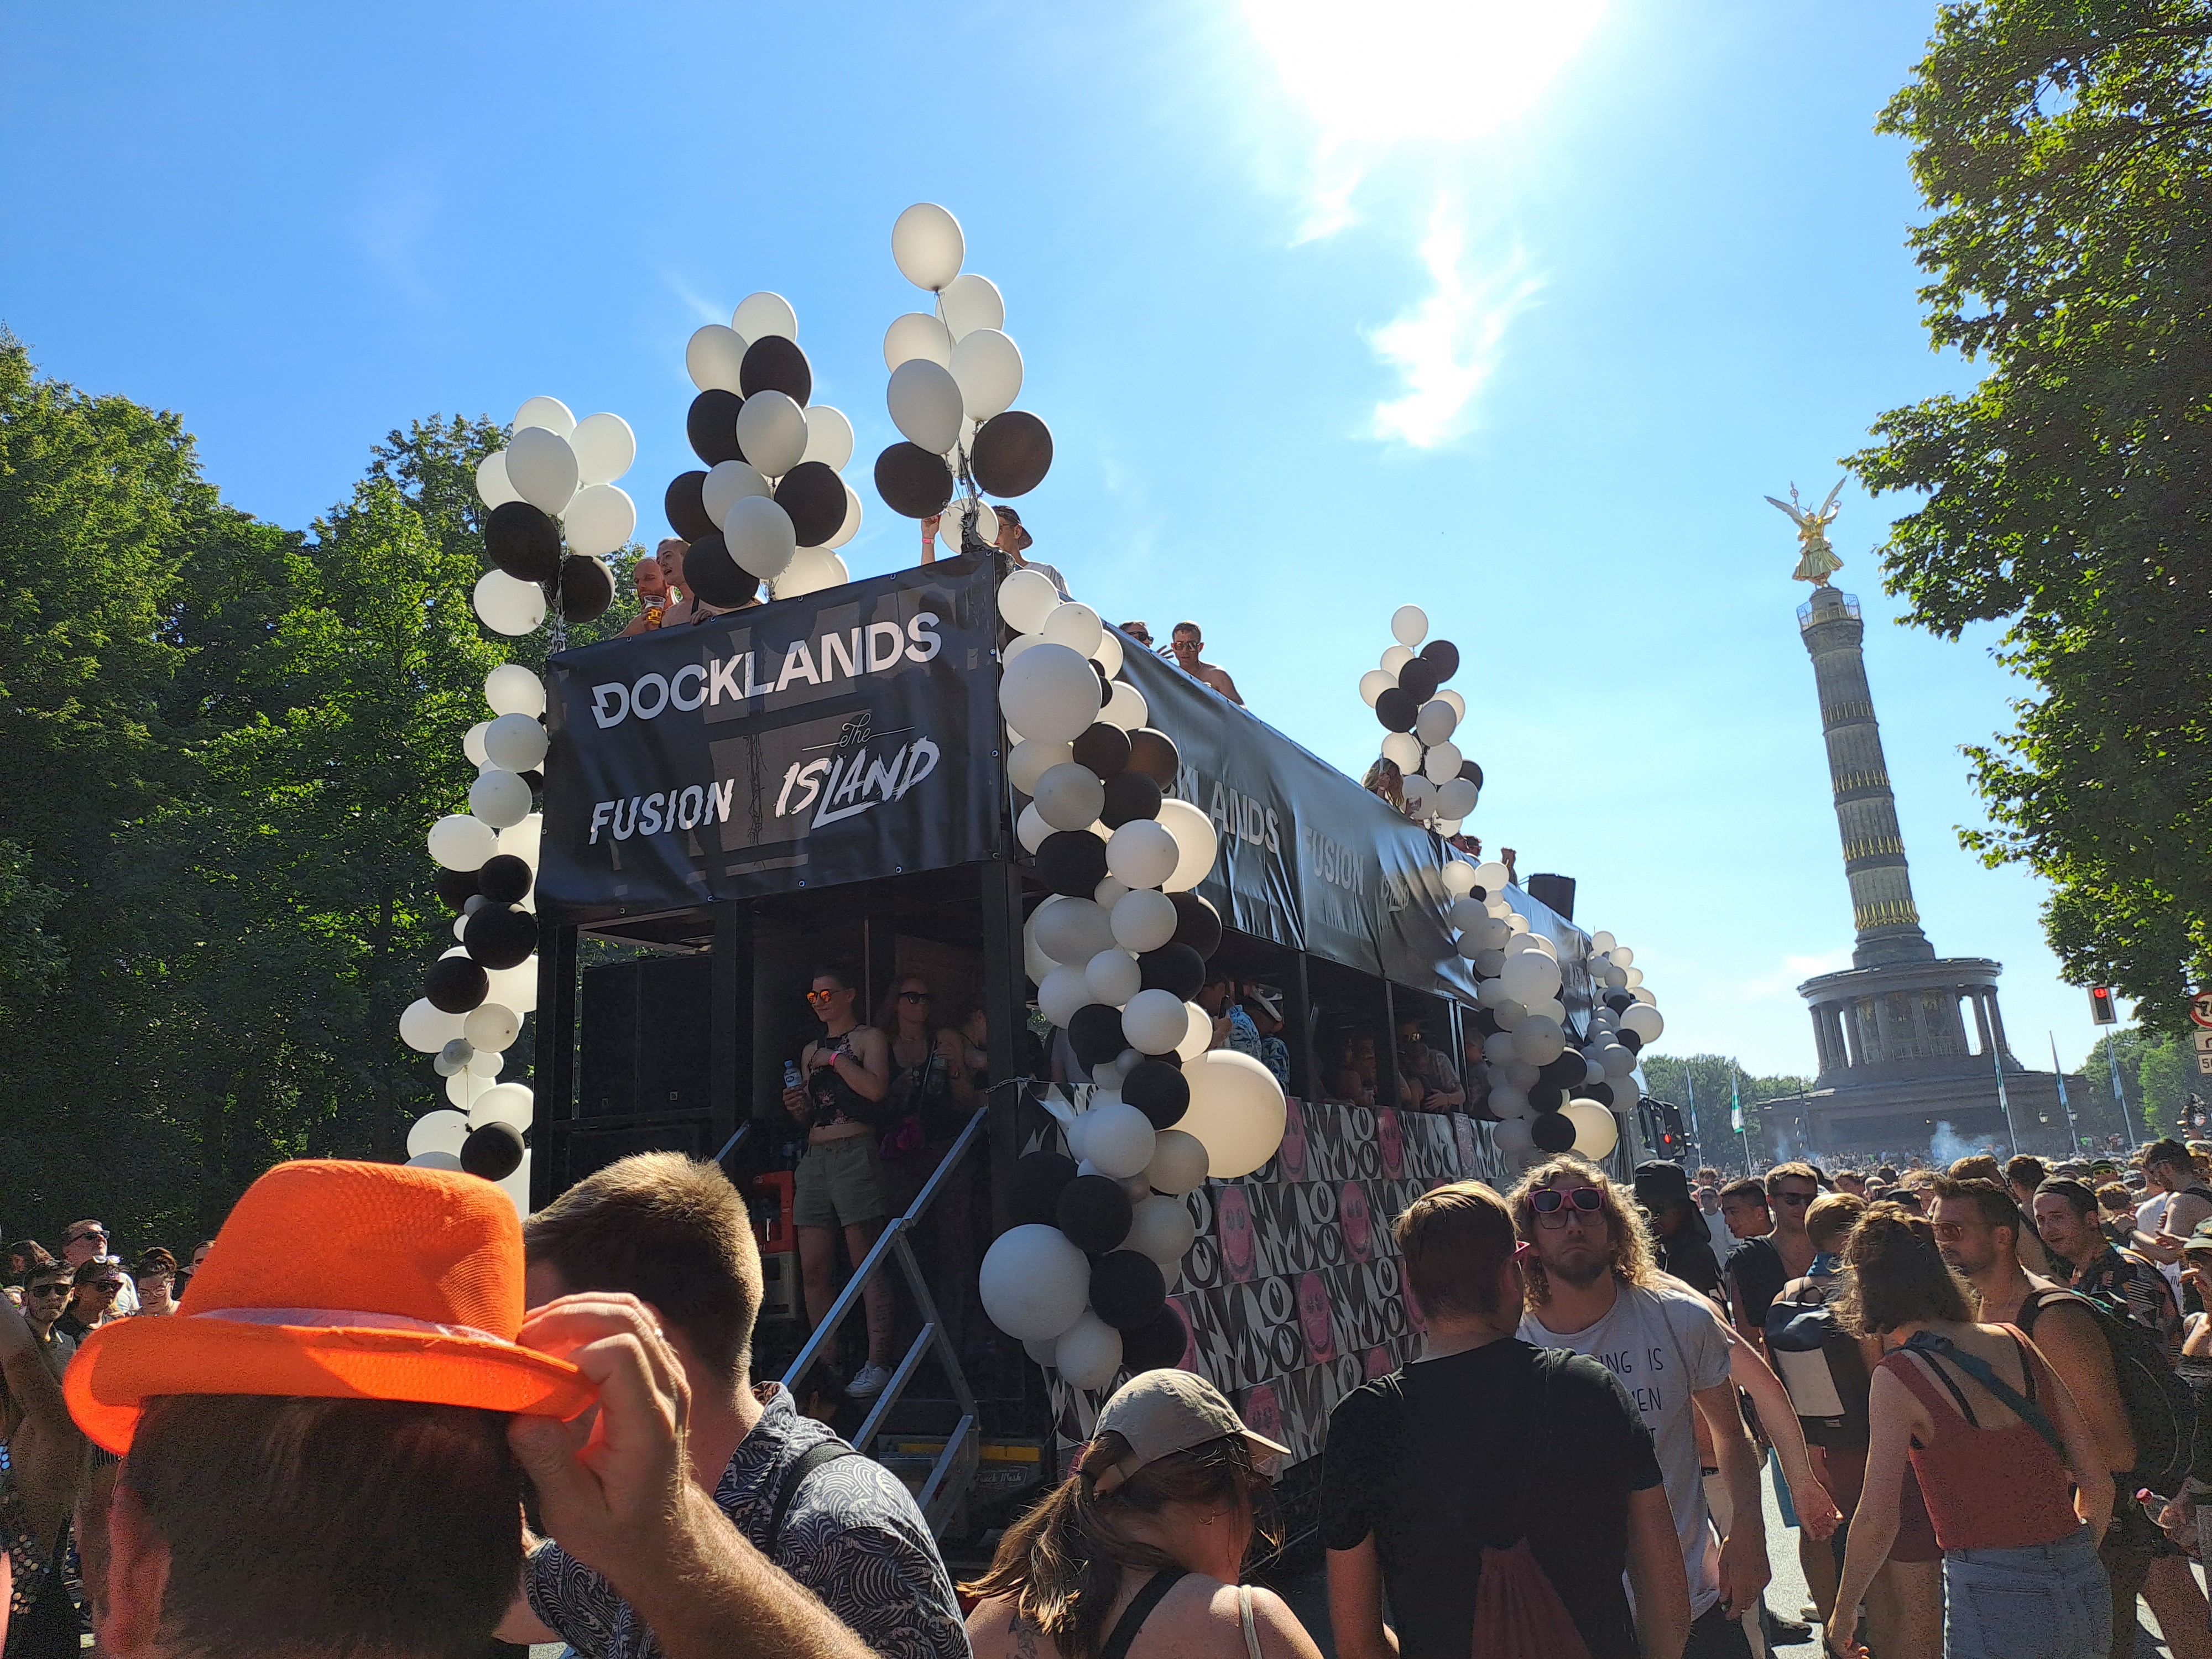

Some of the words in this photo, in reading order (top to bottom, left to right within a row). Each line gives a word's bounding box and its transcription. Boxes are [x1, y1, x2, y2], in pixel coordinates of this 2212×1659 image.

[590, 612, 942, 729] DOCKLANDS
[588, 779, 734, 844] FUSION
[774, 735, 941, 830] ISLAND
[1302, 825, 1364, 896] FUSION
[2202, 1058, 2212, 1069] 5
[1647, 1348, 1663, 1371] IS
